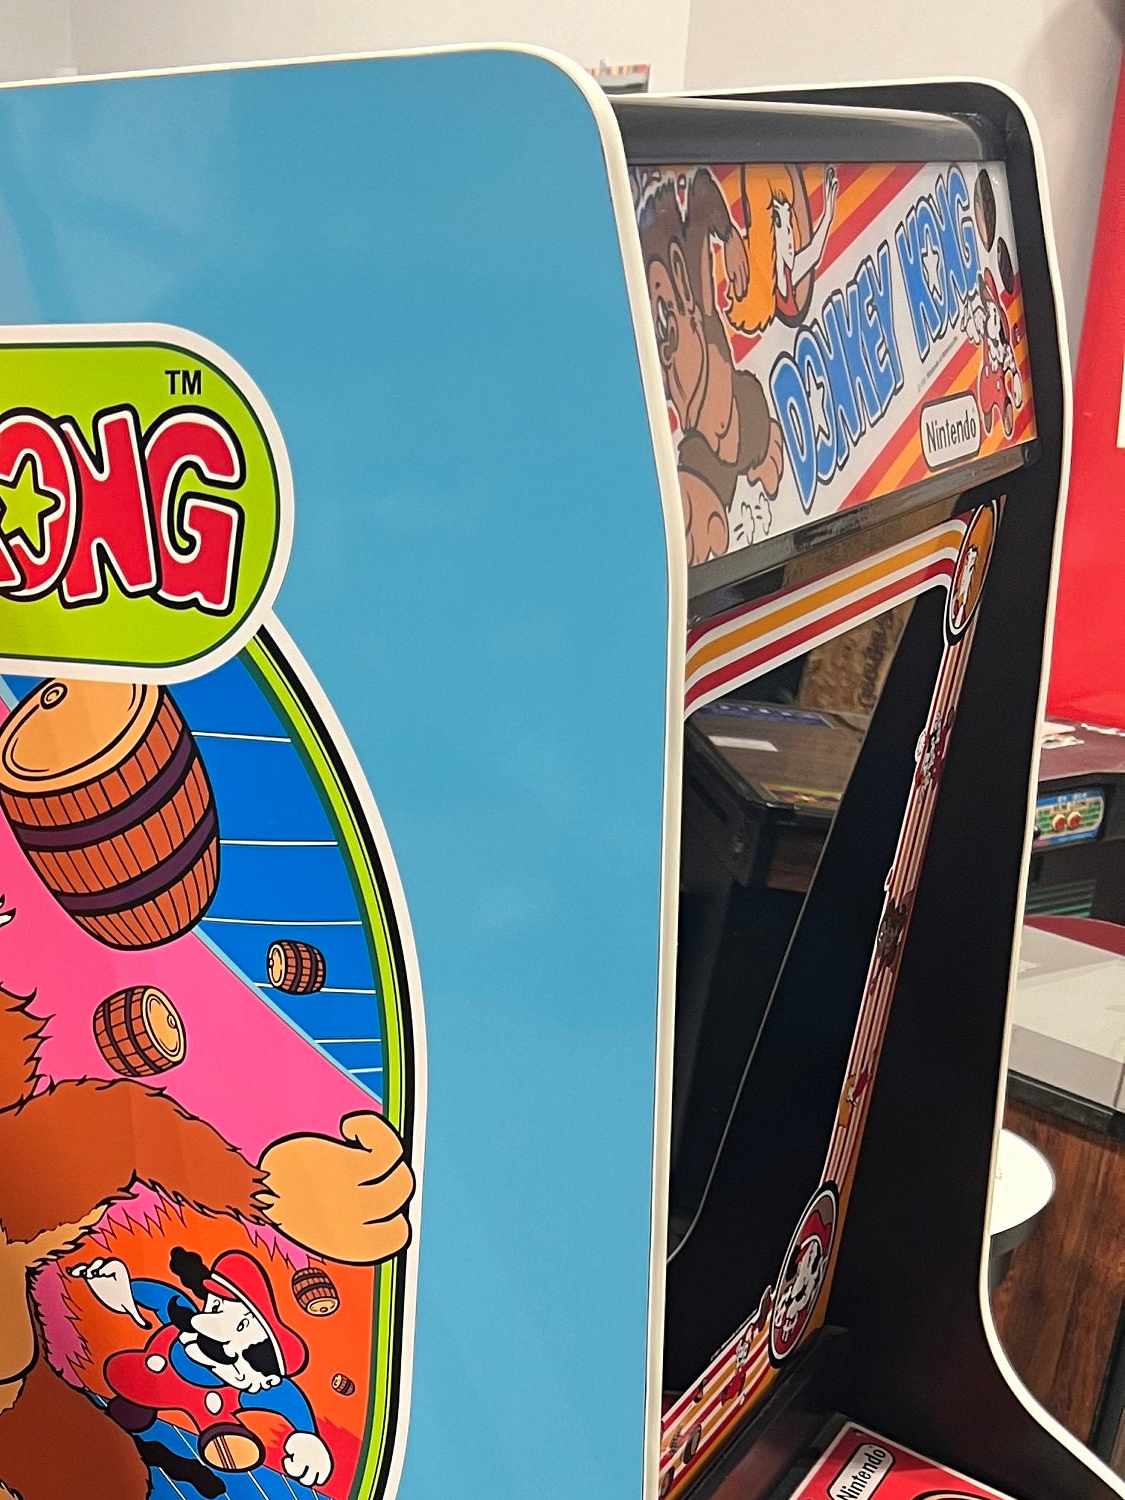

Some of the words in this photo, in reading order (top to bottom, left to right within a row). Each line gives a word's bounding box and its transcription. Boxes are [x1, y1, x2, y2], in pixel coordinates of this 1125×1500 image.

[769, 239, 905, 515] DONKEY
[894, 162, 982, 363] KONG
[164, 369, 203, 396] TM
[926, 416, 976, 454] Nintendo
